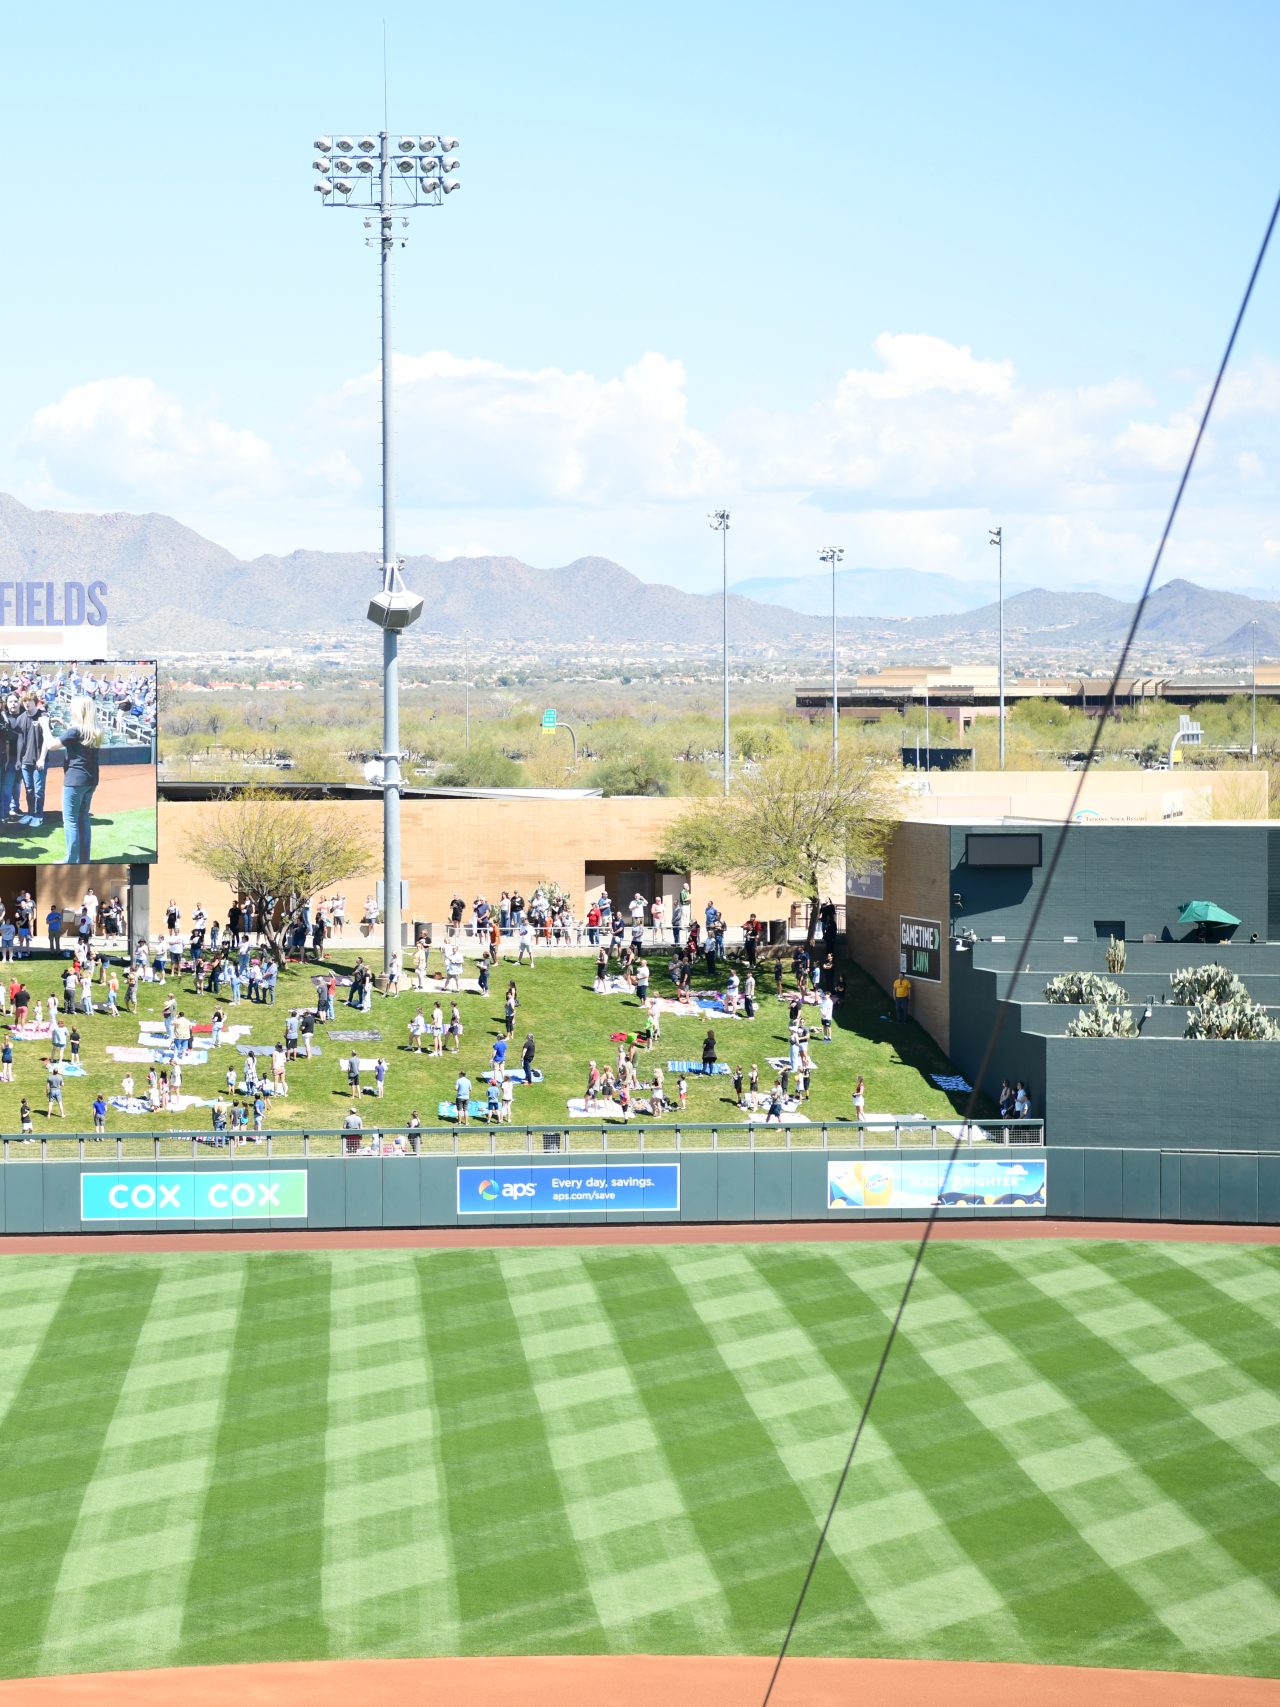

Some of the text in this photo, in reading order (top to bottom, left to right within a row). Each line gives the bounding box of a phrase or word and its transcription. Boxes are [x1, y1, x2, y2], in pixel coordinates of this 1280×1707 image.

[902, 923, 934, 950] GAMETIME
[912, 950, 929, 973] LAWN
[502, 1182, 536, 1200] aps
[552, 1176, 655, 1190] Every day, savings.
[951, 1175, 1018, 1190] BRIGHTER
[108, 1182, 280, 1209] COX COX
[552, 1191, 616, 1201] aps.com/save
